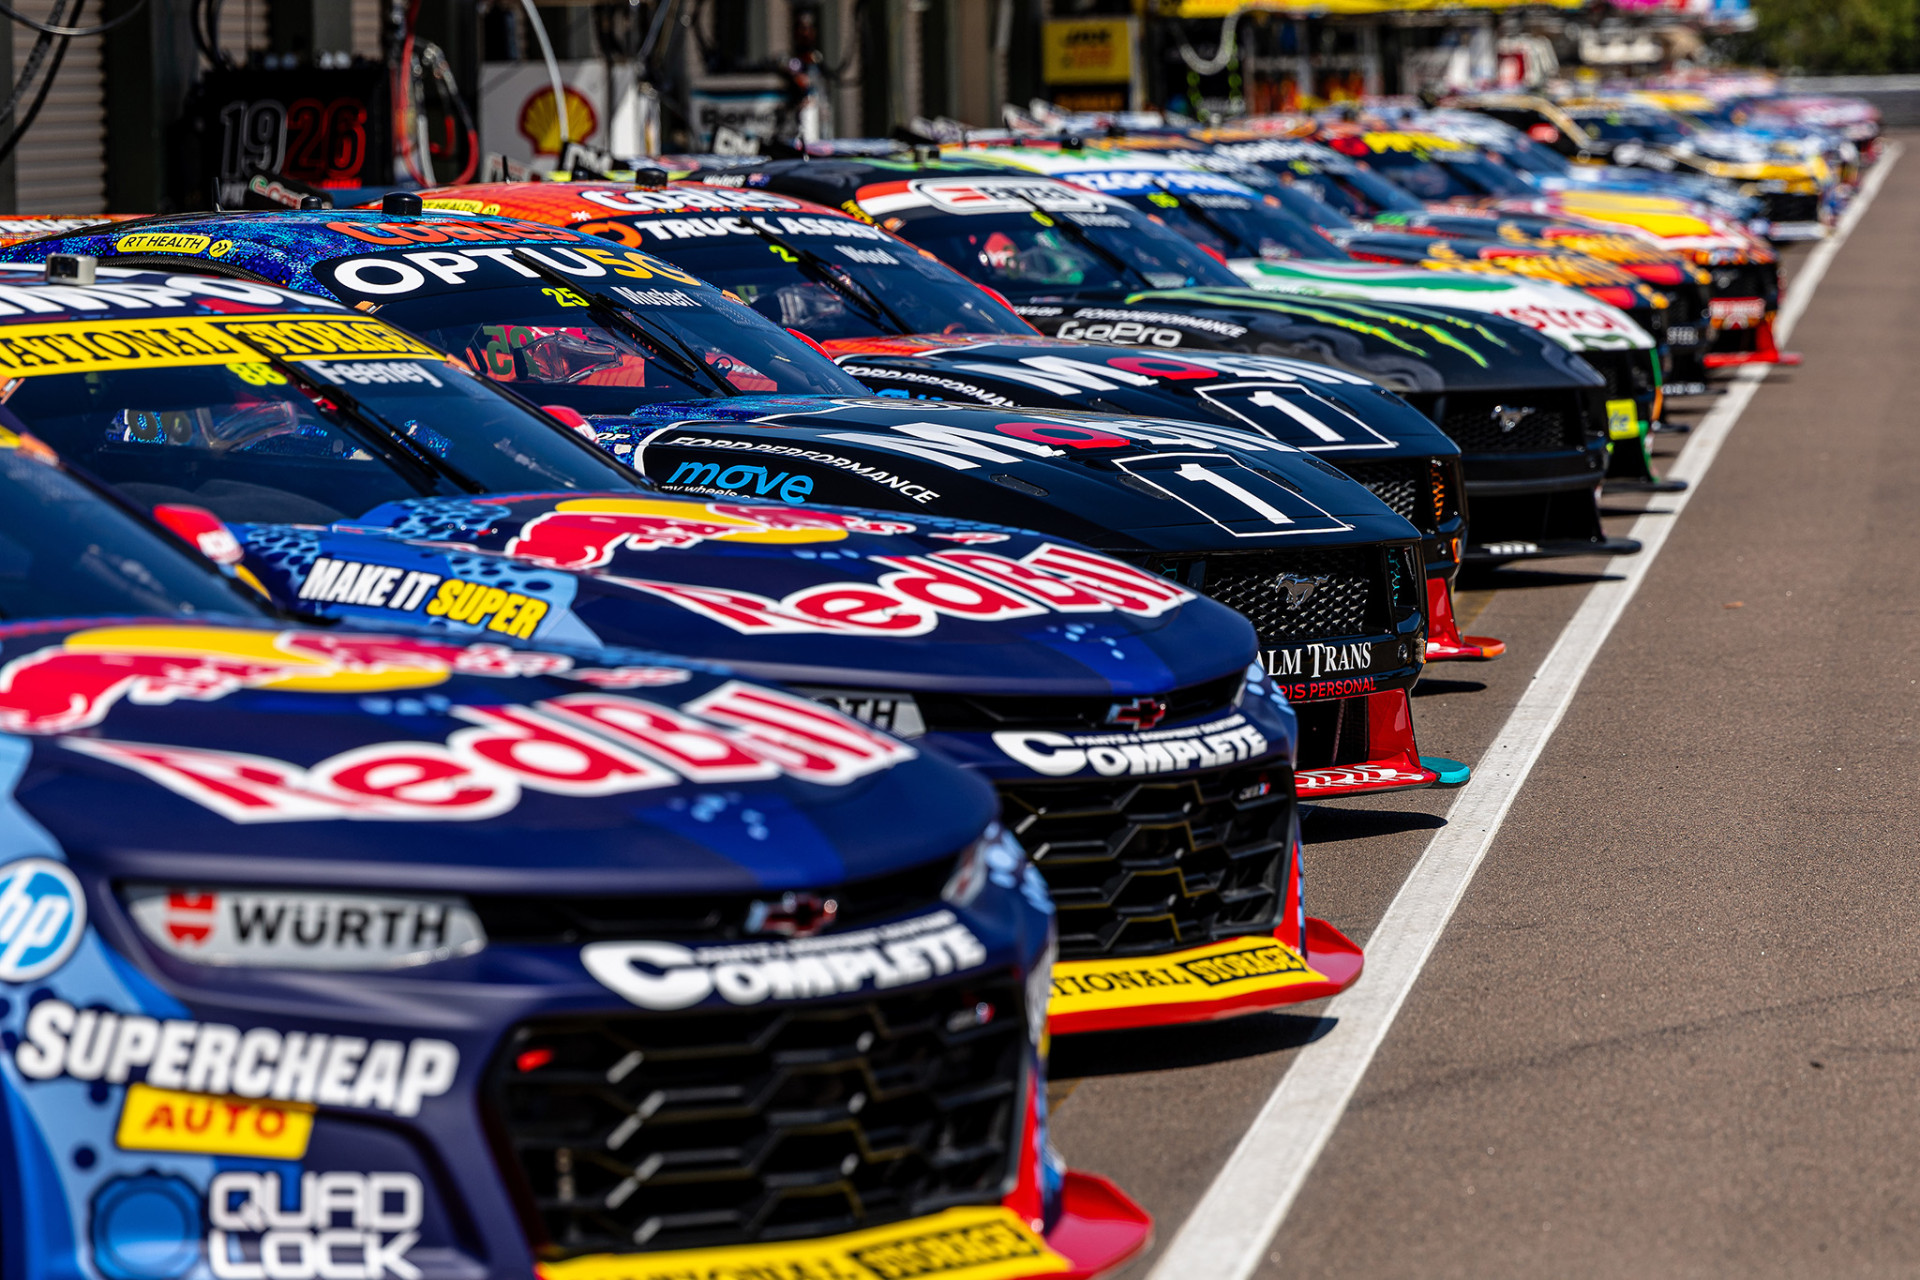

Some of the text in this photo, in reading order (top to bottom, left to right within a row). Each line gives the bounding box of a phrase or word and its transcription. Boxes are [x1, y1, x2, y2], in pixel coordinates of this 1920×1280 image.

[124, 235, 204, 249] RT HEALTH
[541, 288, 591, 307] 25
[1056, 320, 1182, 348] GoPro
[300, 359, 444, 388] Feeney
[1248, 391, 1345, 442] 1
[666, 461, 815, 504] move
[1174, 463, 1295, 524] 1
[298, 558, 549, 640] MAKE IT SUPER
[1307, 642, 1372, 678] TRANS
[1309, 677, 1377, 699] PERSONAL
[991, 723, 1268, 776] COMPLETE
[231, 903, 450, 949] WÜRTH
[579, 923, 987, 1011] COMPLETE
[16, 998, 460, 1117] SUPERCHEAP
[143, 1102, 288, 1139] AUTO
[209, 1171, 424, 1233] QUAD
[208, 1230, 424, 1280] LOCK
